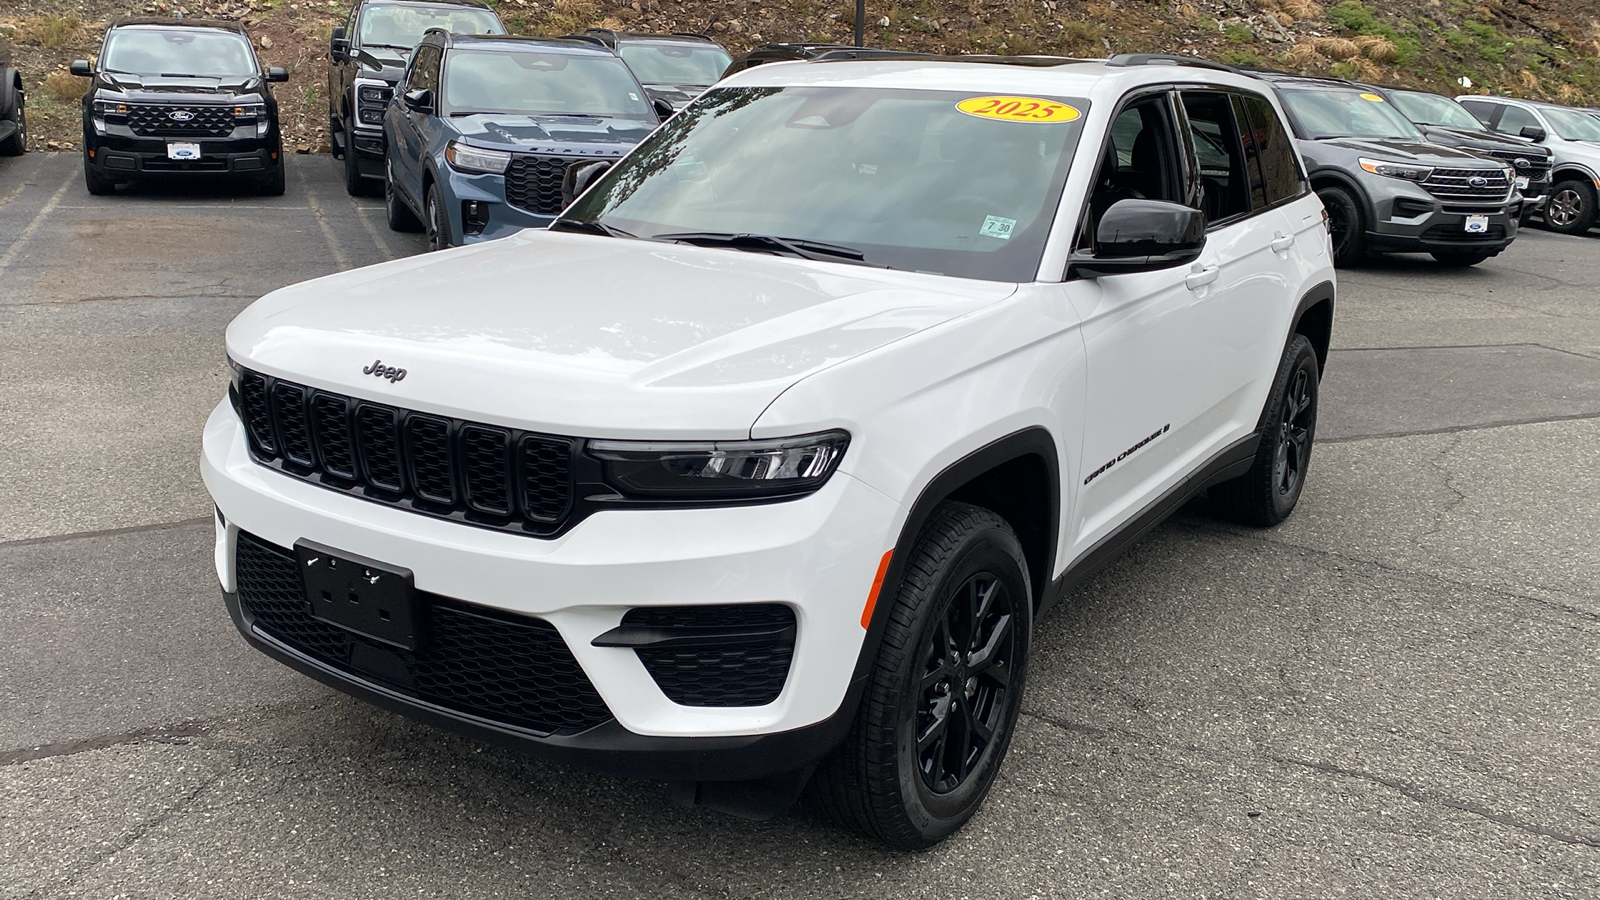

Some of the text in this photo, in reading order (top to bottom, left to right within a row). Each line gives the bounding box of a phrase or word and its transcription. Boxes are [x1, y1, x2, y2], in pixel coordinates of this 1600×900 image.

[973, 99, 1062, 119] 2025
[529, 147, 620, 155] EXPLOR
[999, 223, 1010, 232] 30
[363, 359, 408, 383] Jeep
[1084, 428, 1163, 485] GRAND CHEROKEE
